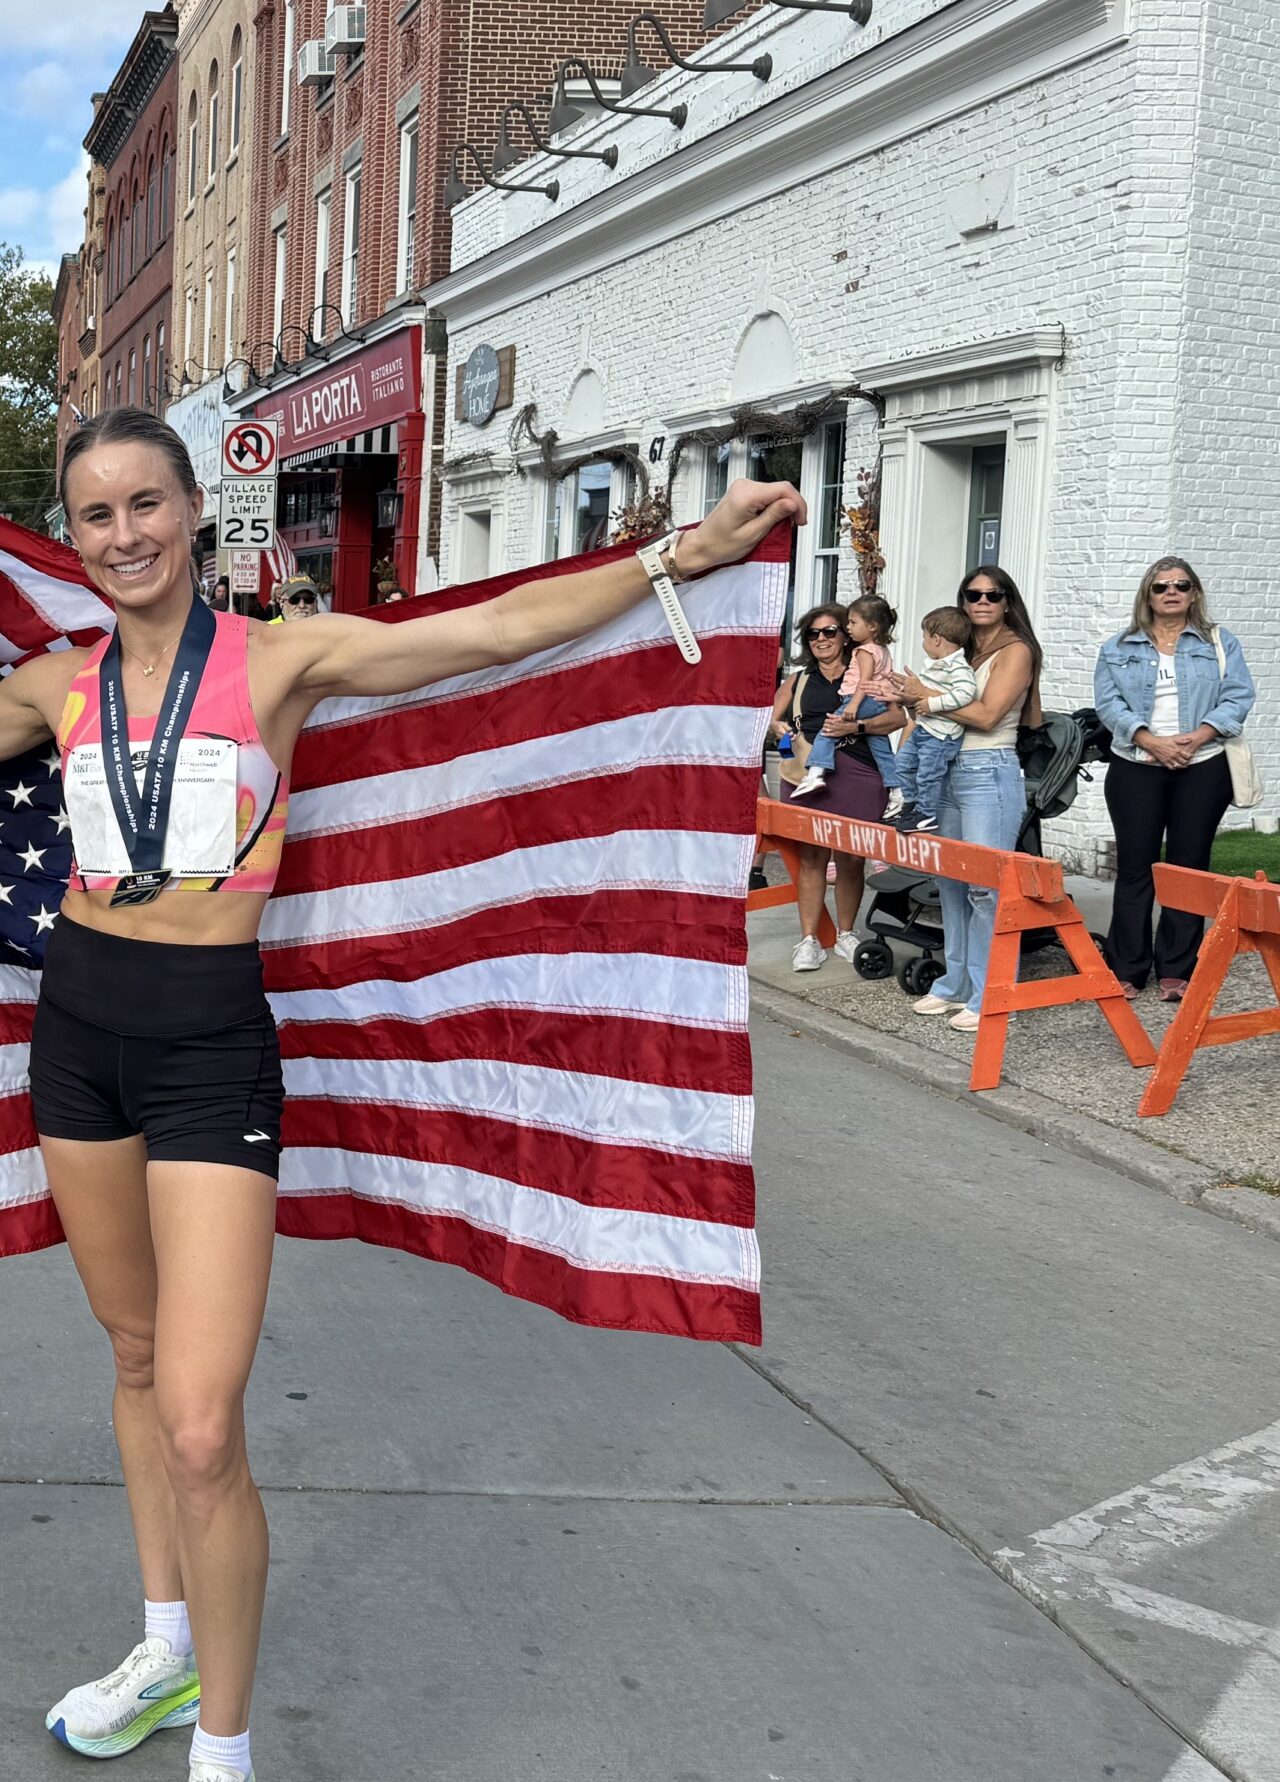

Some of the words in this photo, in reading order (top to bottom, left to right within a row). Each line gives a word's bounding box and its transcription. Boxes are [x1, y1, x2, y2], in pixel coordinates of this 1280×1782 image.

[371, 357, 404, 382] RISTORANTE
[372, 377, 405, 402] ITALIANO
[291, 395, 312, 436] LA
[311, 373, 362, 429] PORTA
[469, 393, 490, 418] HOME
[648, 436, 665, 464] 67
[223, 484, 273, 493] VILLAGE
[228, 495, 267, 504] SPEED
[231, 505, 262, 514] LIMIT
[224, 518, 269, 543] 25
[233, 563, 258, 571] PARKING
[240, 553, 252, 562] NO
[164, 670, 190, 737] Championships
[109, 703, 118, 731] USATF
[111, 733, 119, 745] 10
[159, 739, 169, 755] KM
[112, 746, 122, 762] KM
[156, 756, 165, 768] 10
[198, 749, 220, 757] 2024
[72, 763, 89, 774] M&T
[115, 763, 138, 833] Championships
[151, 771, 162, 803] USATF
[148, 805, 158, 831] 2024
[812, 816, 842, 847] NPT
[849, 823, 887, 859] HWY
[895, 831, 942, 872] DEPT
